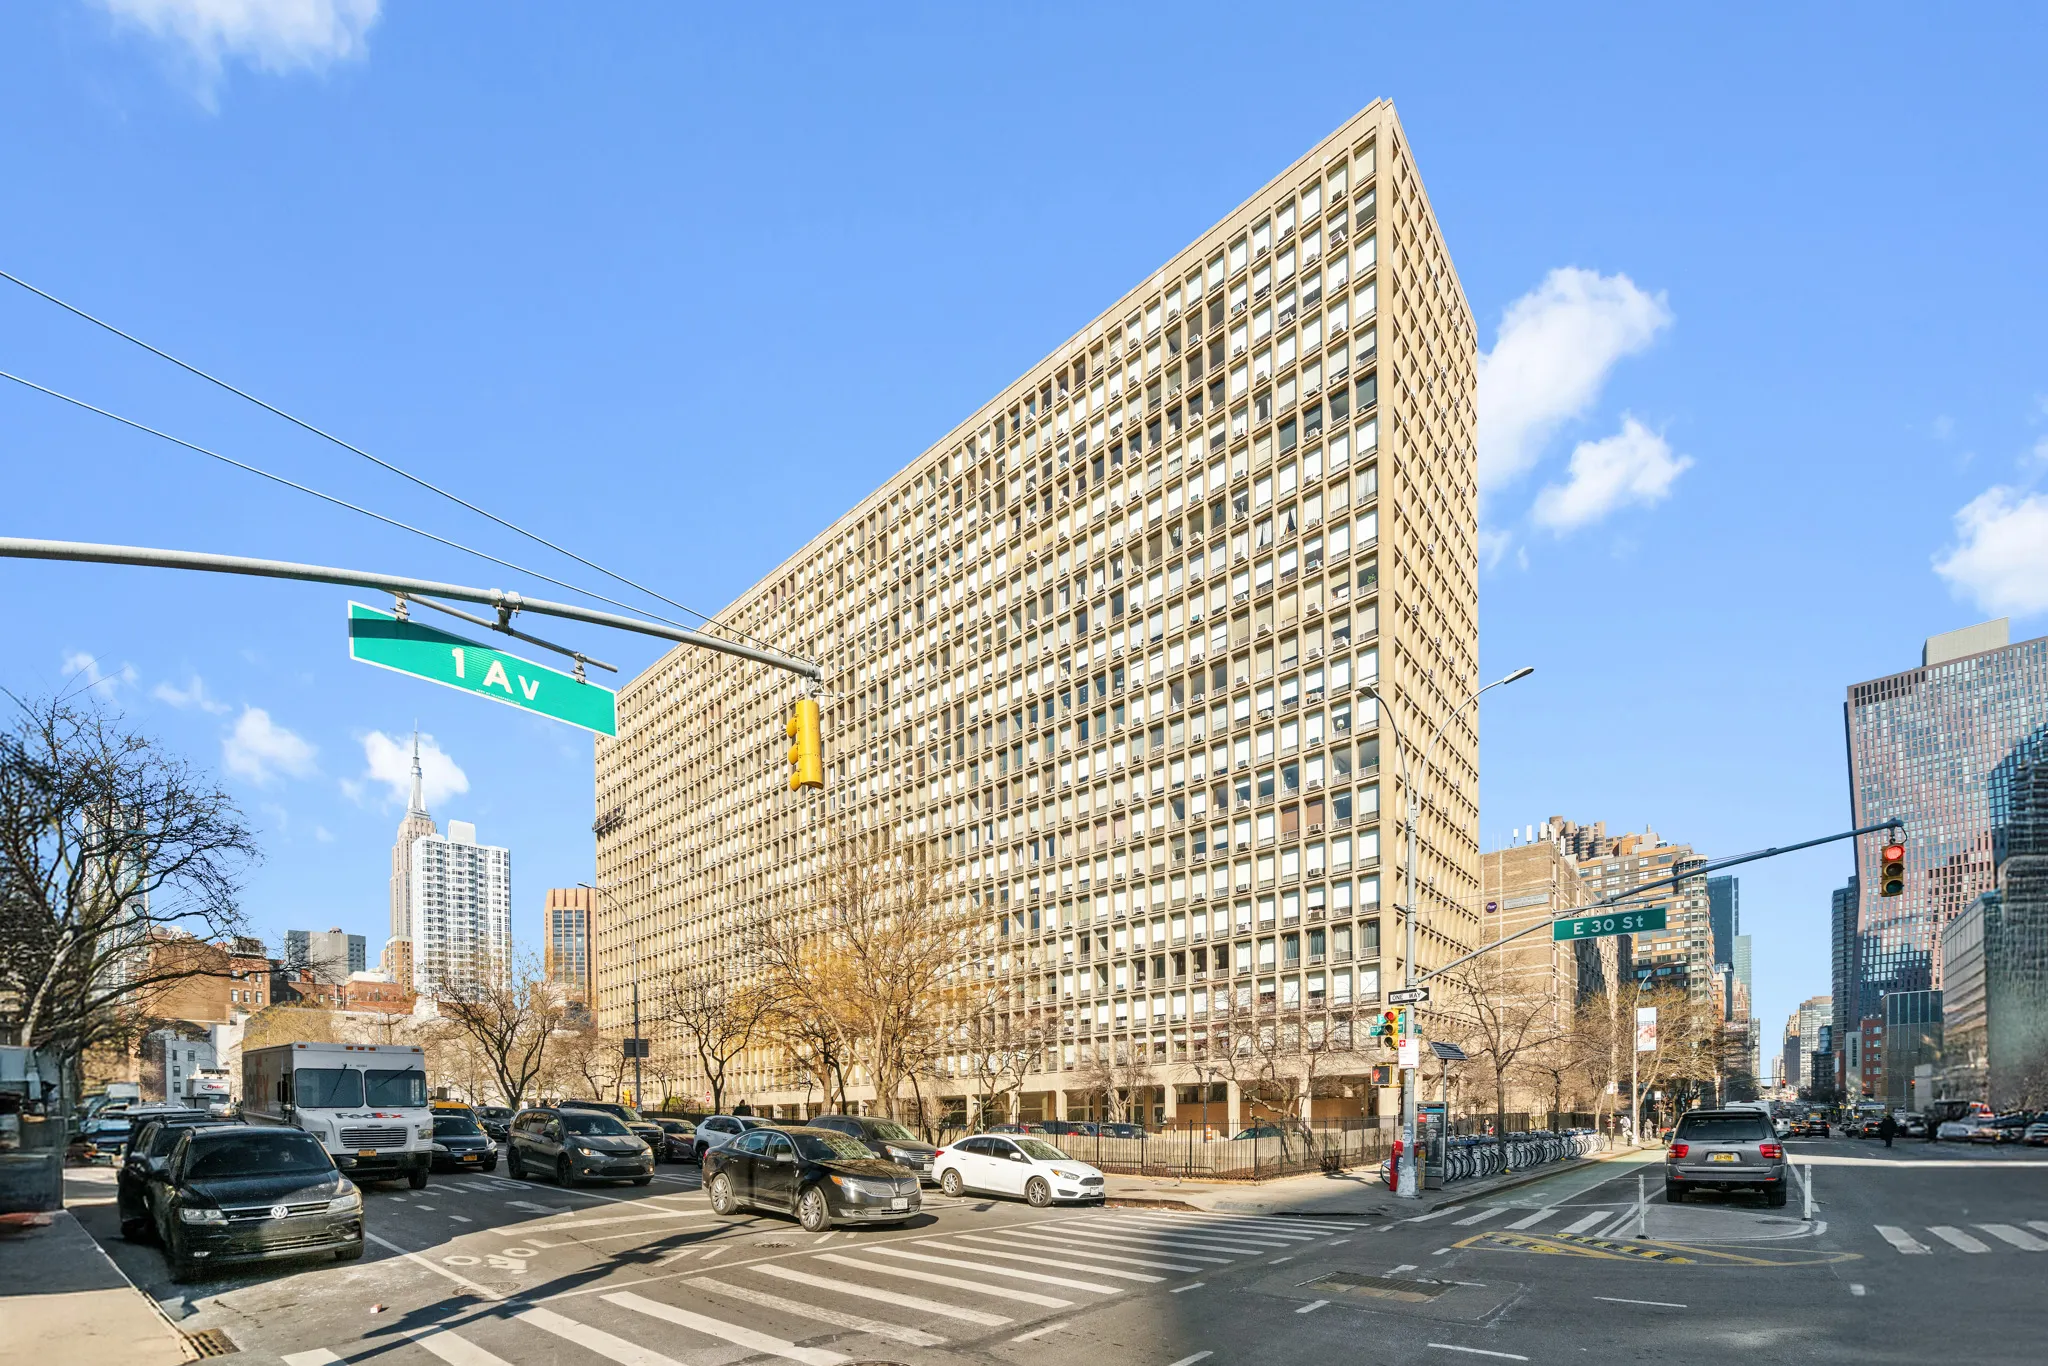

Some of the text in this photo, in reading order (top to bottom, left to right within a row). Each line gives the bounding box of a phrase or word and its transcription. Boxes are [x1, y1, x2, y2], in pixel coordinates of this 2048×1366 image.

[451, 647, 465, 679] 1
[482, 660, 540, 701] Av
[1573, 914, 1644, 935] E 30 St
[1409, 991, 1421, 999] WAY
